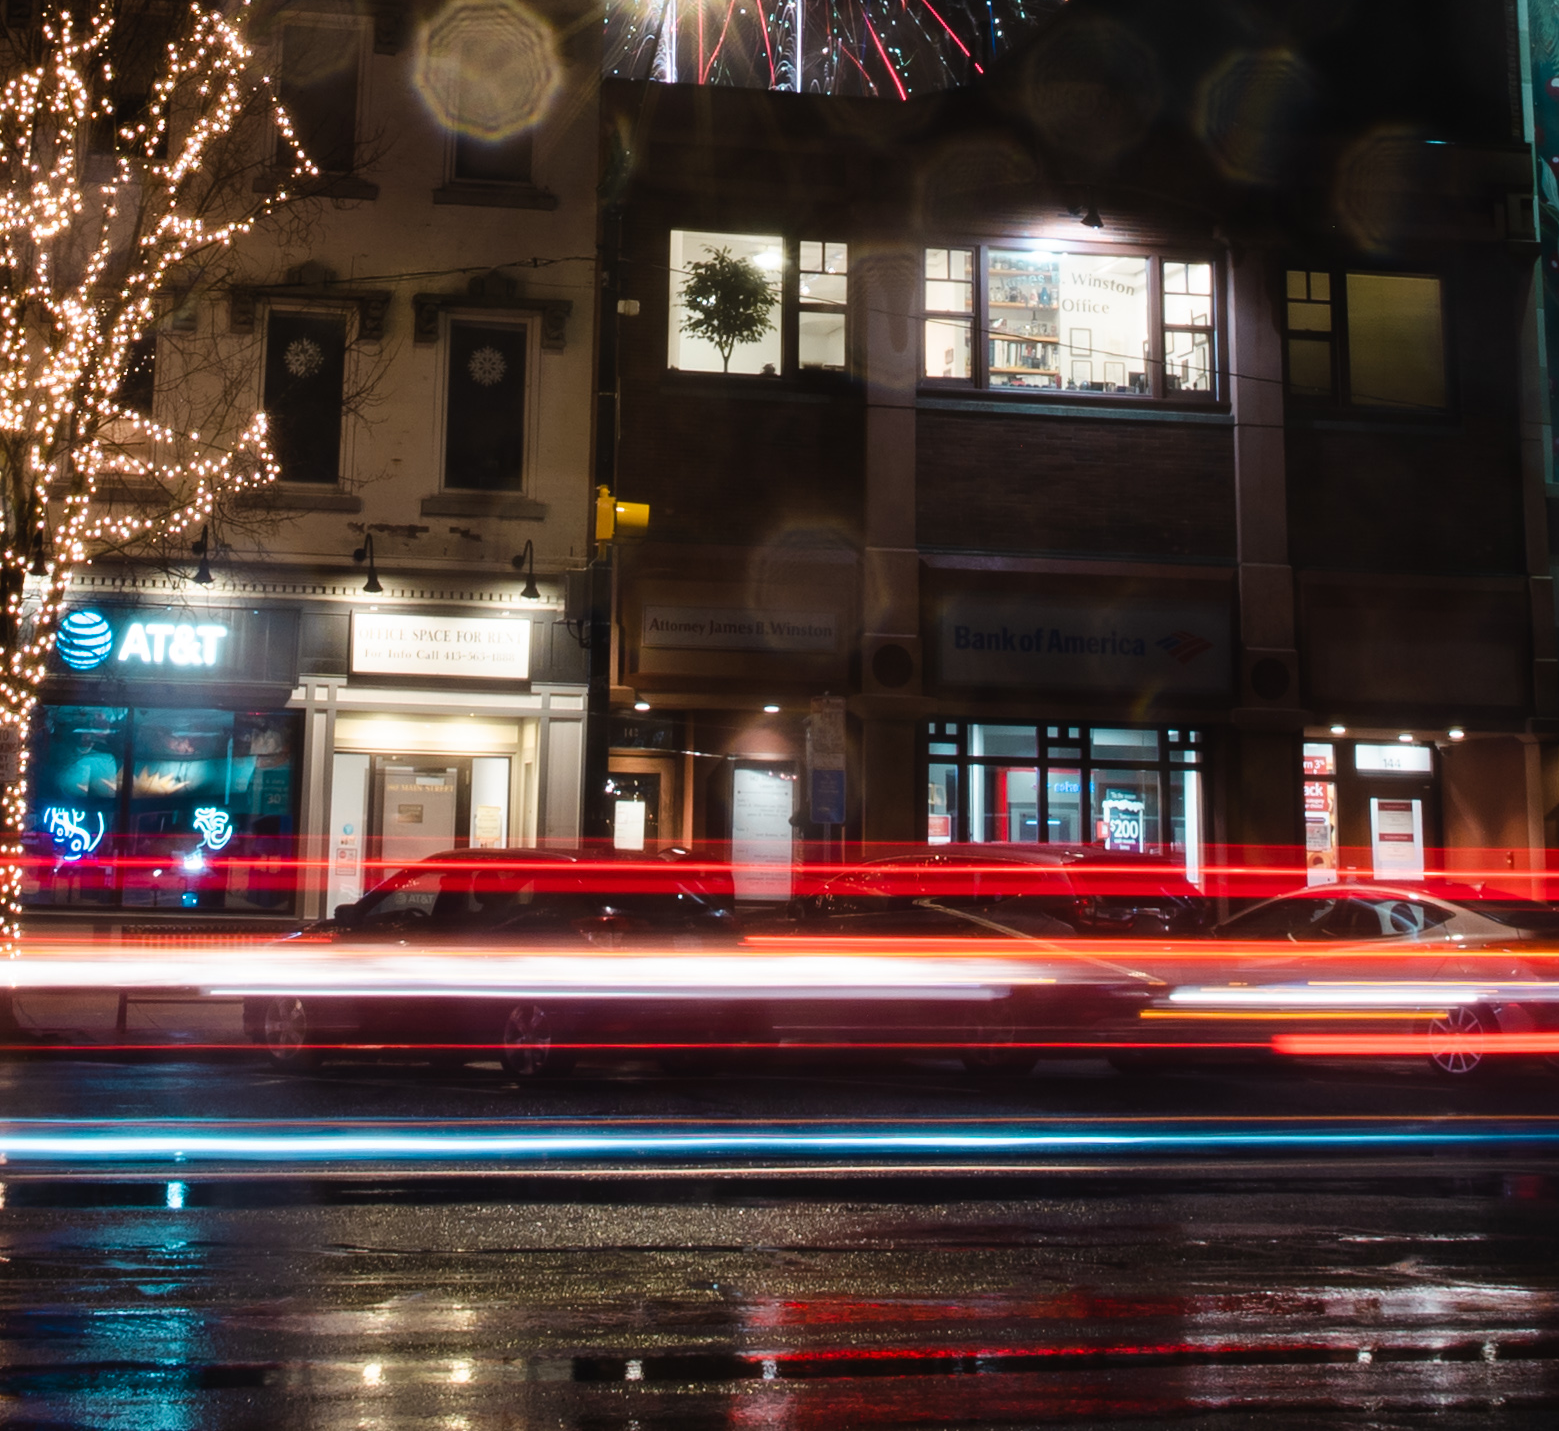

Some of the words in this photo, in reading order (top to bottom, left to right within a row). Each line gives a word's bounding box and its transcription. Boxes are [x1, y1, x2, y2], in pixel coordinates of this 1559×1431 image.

[1072, 273, 1135, 296] Winston
[1062, 299, 1110, 314] Office
[359, 628, 408, 641] OFFICE
[412, 629, 451, 642] SPACE
[456, 630, 481, 643] FOR
[488, 632, 522, 644] RENT
[649, 617, 705, 635] Attorney
[709, 620, 753, 636] James
[771, 621, 832, 637] Winston
[117, 622, 228, 666] AT&T
[954, 625, 1016, 651] Bank
[1020, 627, 1044, 652] of
[1048, 629, 1146, 656] America
[416, 650, 439, 660] Call
[1383, 759, 1401, 768] 144
[1110, 820, 1138, 838] $200
